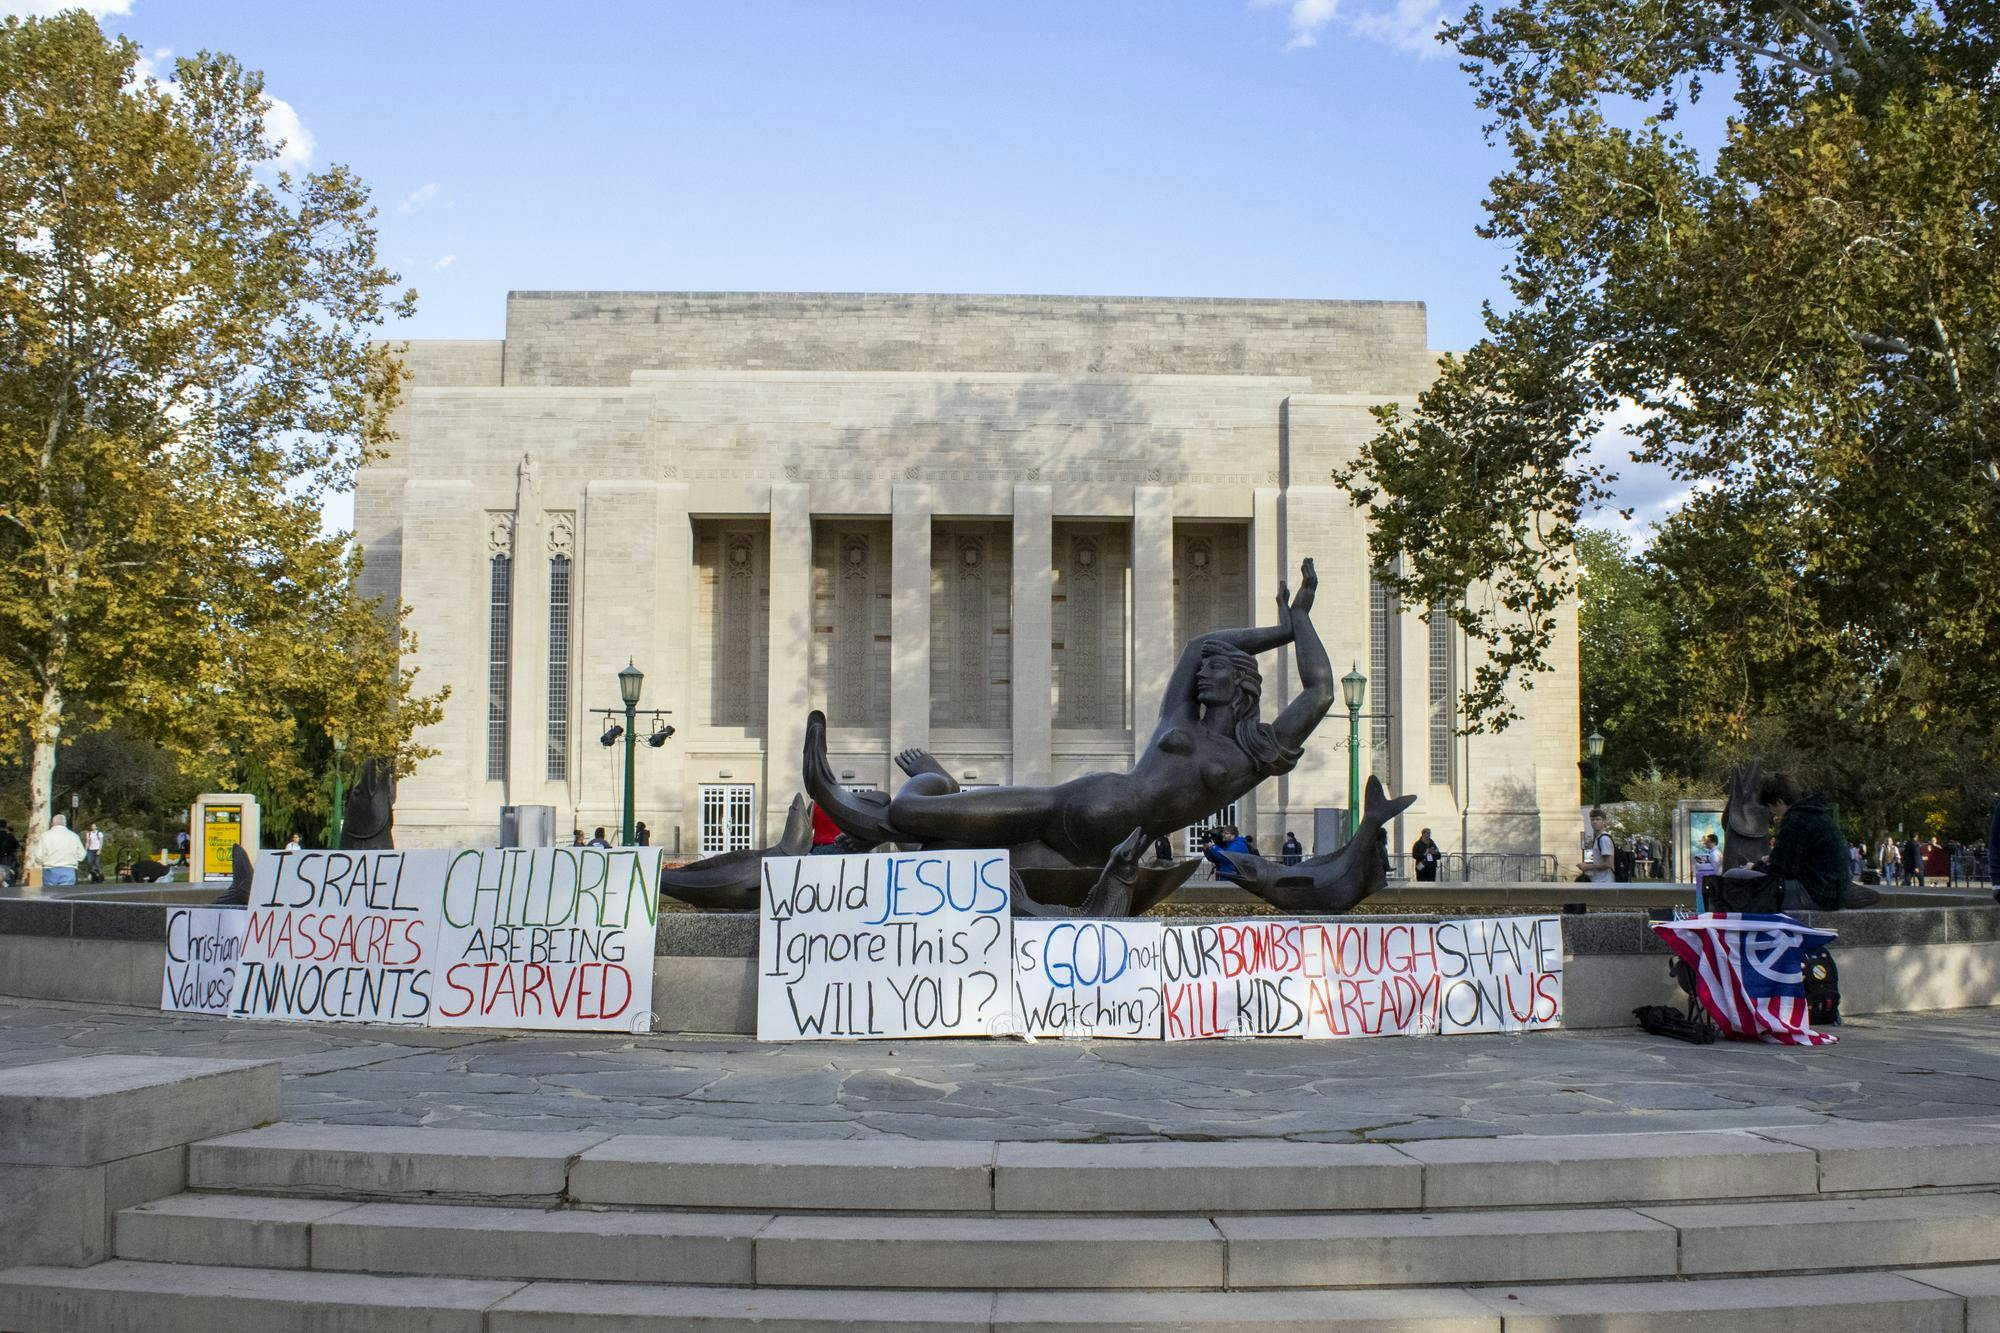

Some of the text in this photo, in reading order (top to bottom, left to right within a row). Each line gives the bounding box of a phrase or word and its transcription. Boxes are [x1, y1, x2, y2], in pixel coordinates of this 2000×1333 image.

[261, 851, 419, 911] ISRAEL
[443, 849, 663, 929] CHILDREN
[764, 857, 1008, 925] Would JESUS
[167, 910, 239, 966] Christian
[241, 910, 424, 965] MASSACRES
[461, 927, 625, 964] ARE BEING
[765, 915, 1001, 985] Ignore This?
[1043, 923, 1128, 989] GOD
[1128, 941, 1160, 971] not
[1162, 923, 1301, 982] OUR BOMBS
[1300, 924, 1438, 979] ENOUGH
[1436, 919, 1562, 978] SHAME
[167, 963, 236, 1009] Values?
[233, 962, 431, 1018] INNOCENTS
[439, 963, 632, 1020] STARVED
[787, 970, 998, 1035] WILL YOU?
[1015, 980, 1160, 1034] Watching?
[1163, 976, 1303, 1038] KILL KIDS
[1445, 972, 1558, 1027] ON US
